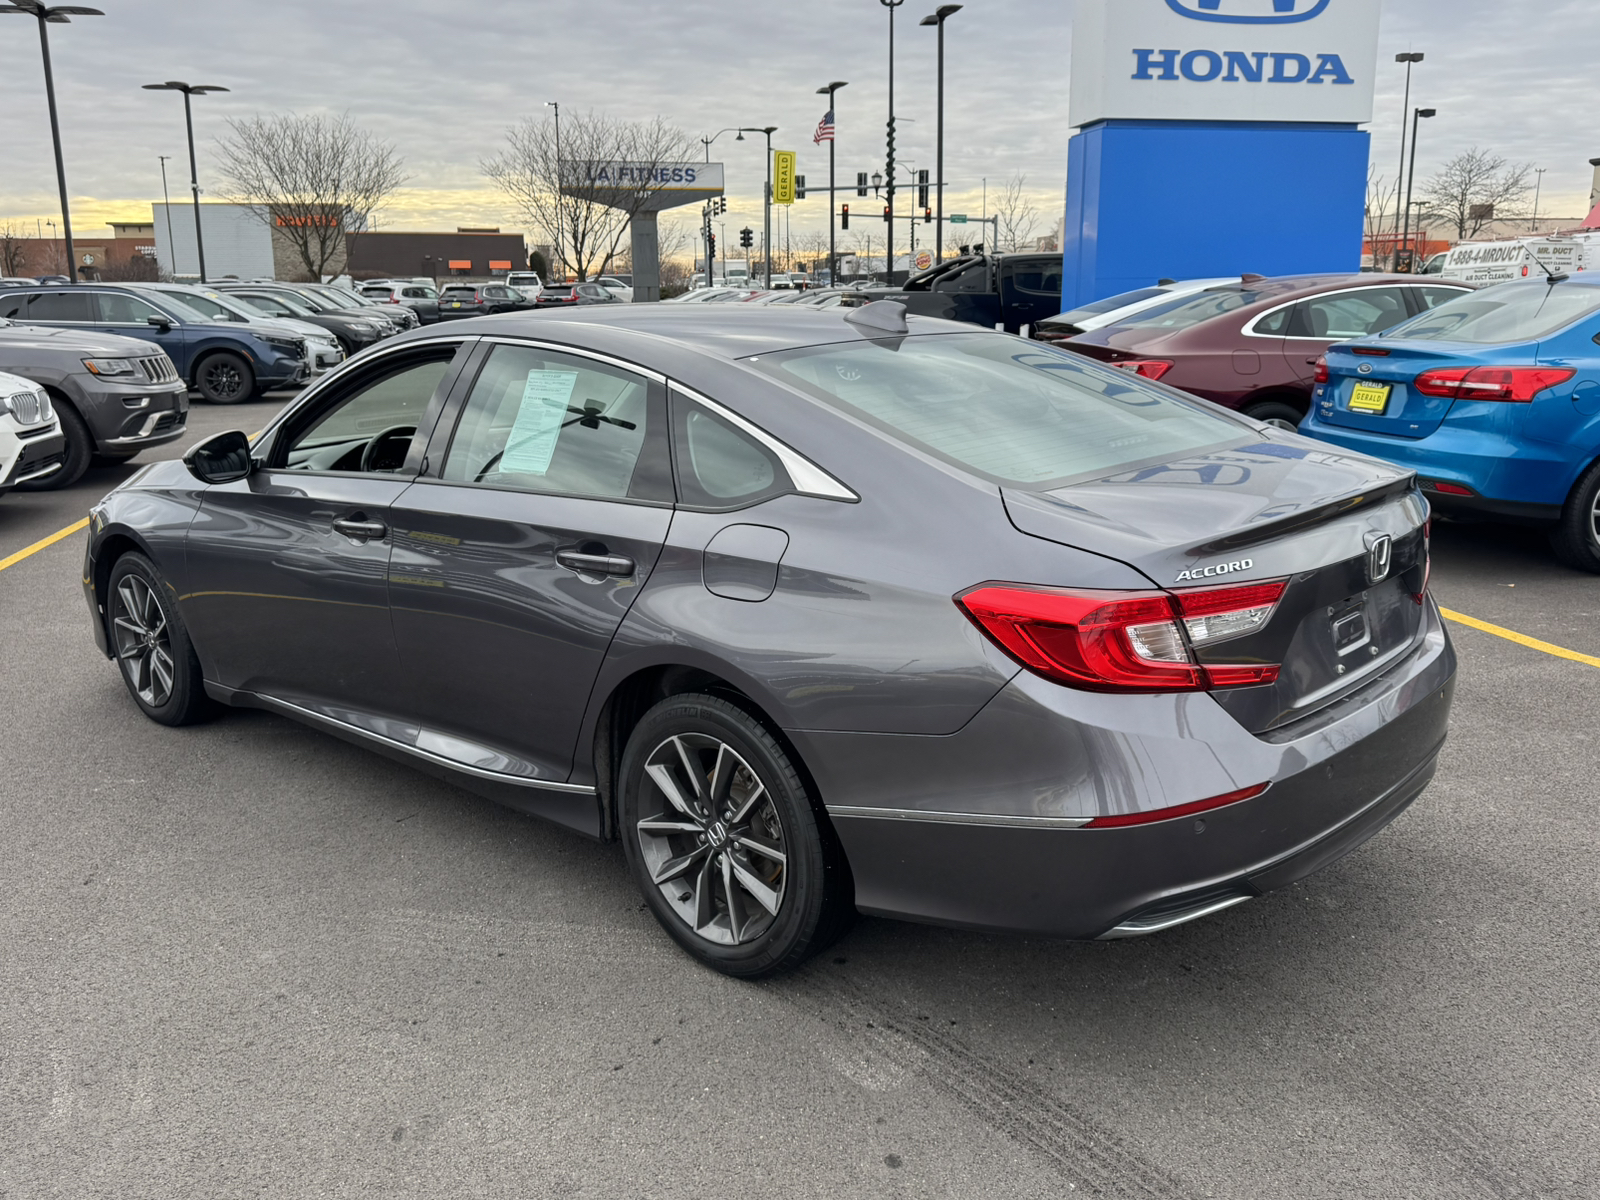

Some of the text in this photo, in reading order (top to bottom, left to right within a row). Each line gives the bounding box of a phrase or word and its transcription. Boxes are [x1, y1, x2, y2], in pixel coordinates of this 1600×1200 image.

[1131, 49, 1354, 84] HONDA
[618, 167, 696, 183] FITNESS
[780, 157, 789, 198] GERALD
[1448, 245, 1524, 266] 1-888-4-MRDUCT
[1537, 247, 1573, 255] MR. DUCT
[1488, 272, 1514, 280] CLEANING
[1361, 381, 1383, 389] GERALD
[1356, 392, 1382, 403] GERALD
[1174, 558, 1253, 583] ACCORD
